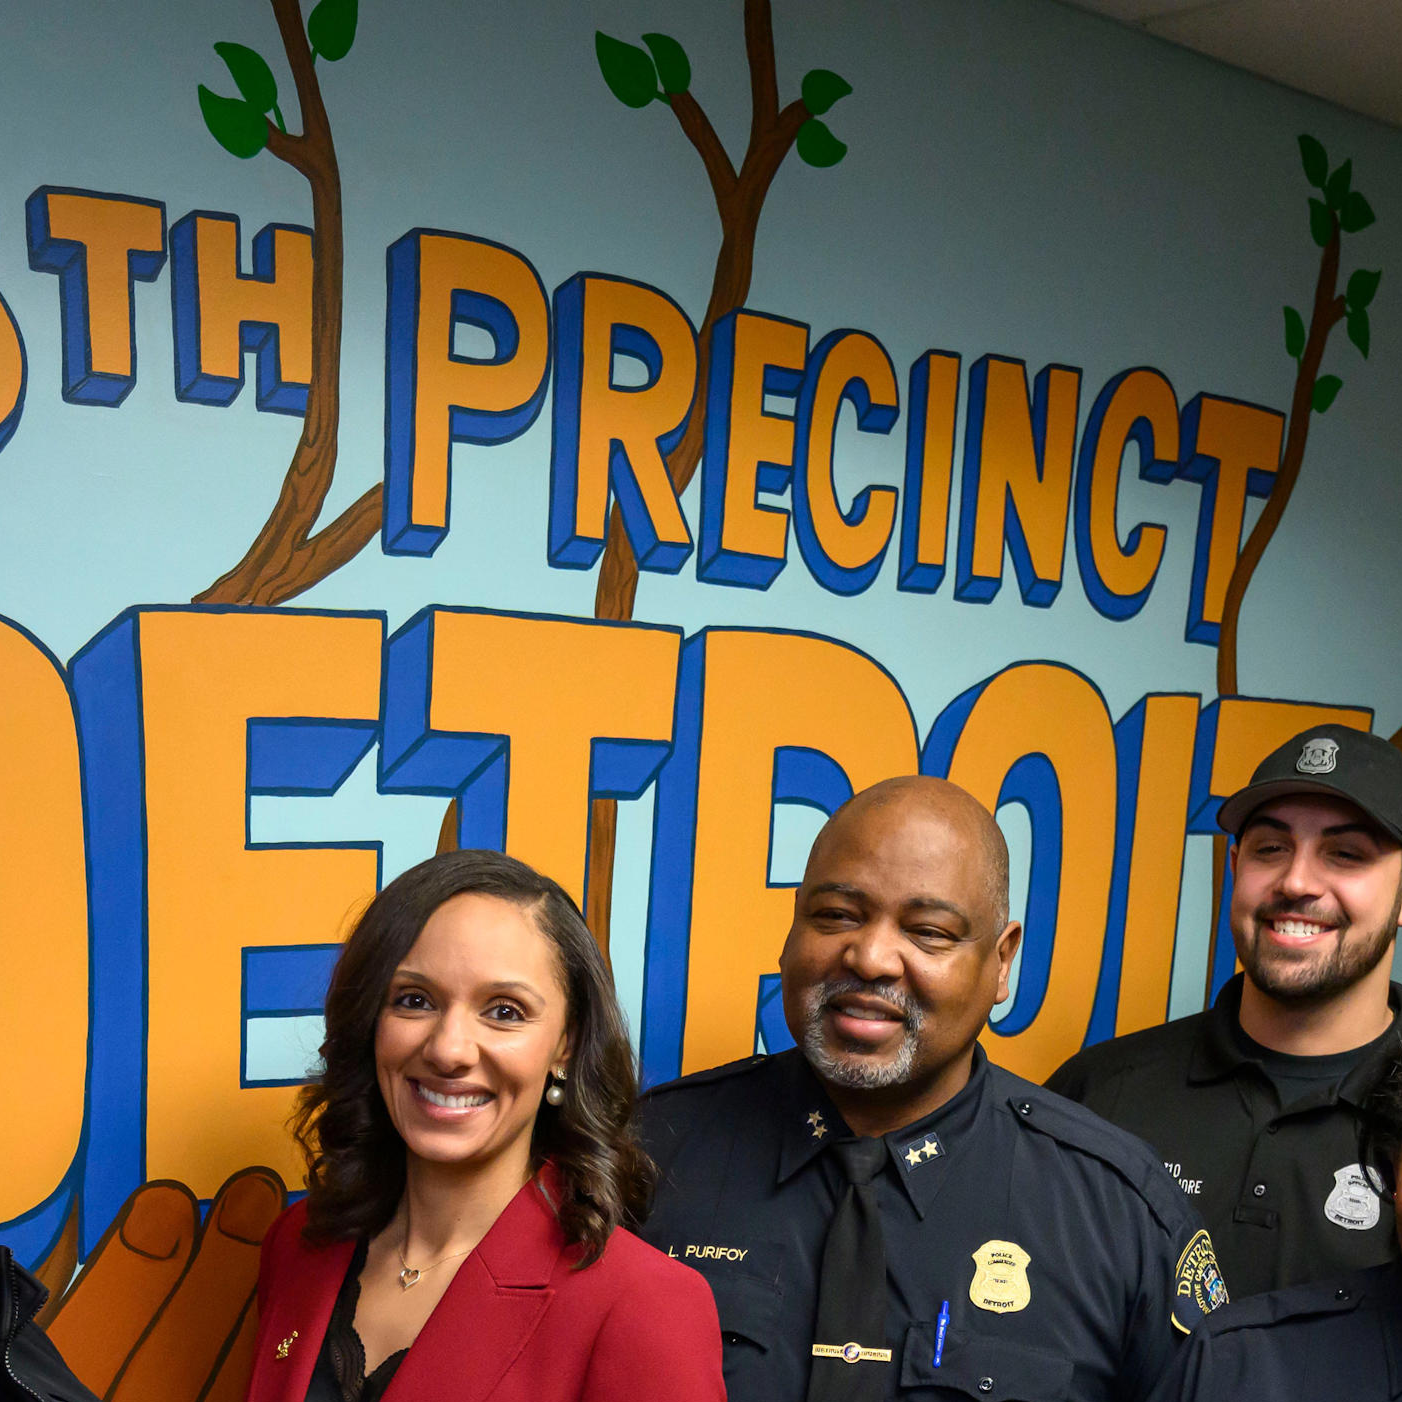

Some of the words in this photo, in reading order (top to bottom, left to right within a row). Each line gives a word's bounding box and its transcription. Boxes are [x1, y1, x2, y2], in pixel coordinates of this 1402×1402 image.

[382, 228, 1286, 646] PRECINCT
[668, 1245, 680, 1258] L.
[685, 1244, 748, 1262] PURIFOY
[983, 1298, 1015, 1308] DETROIT
